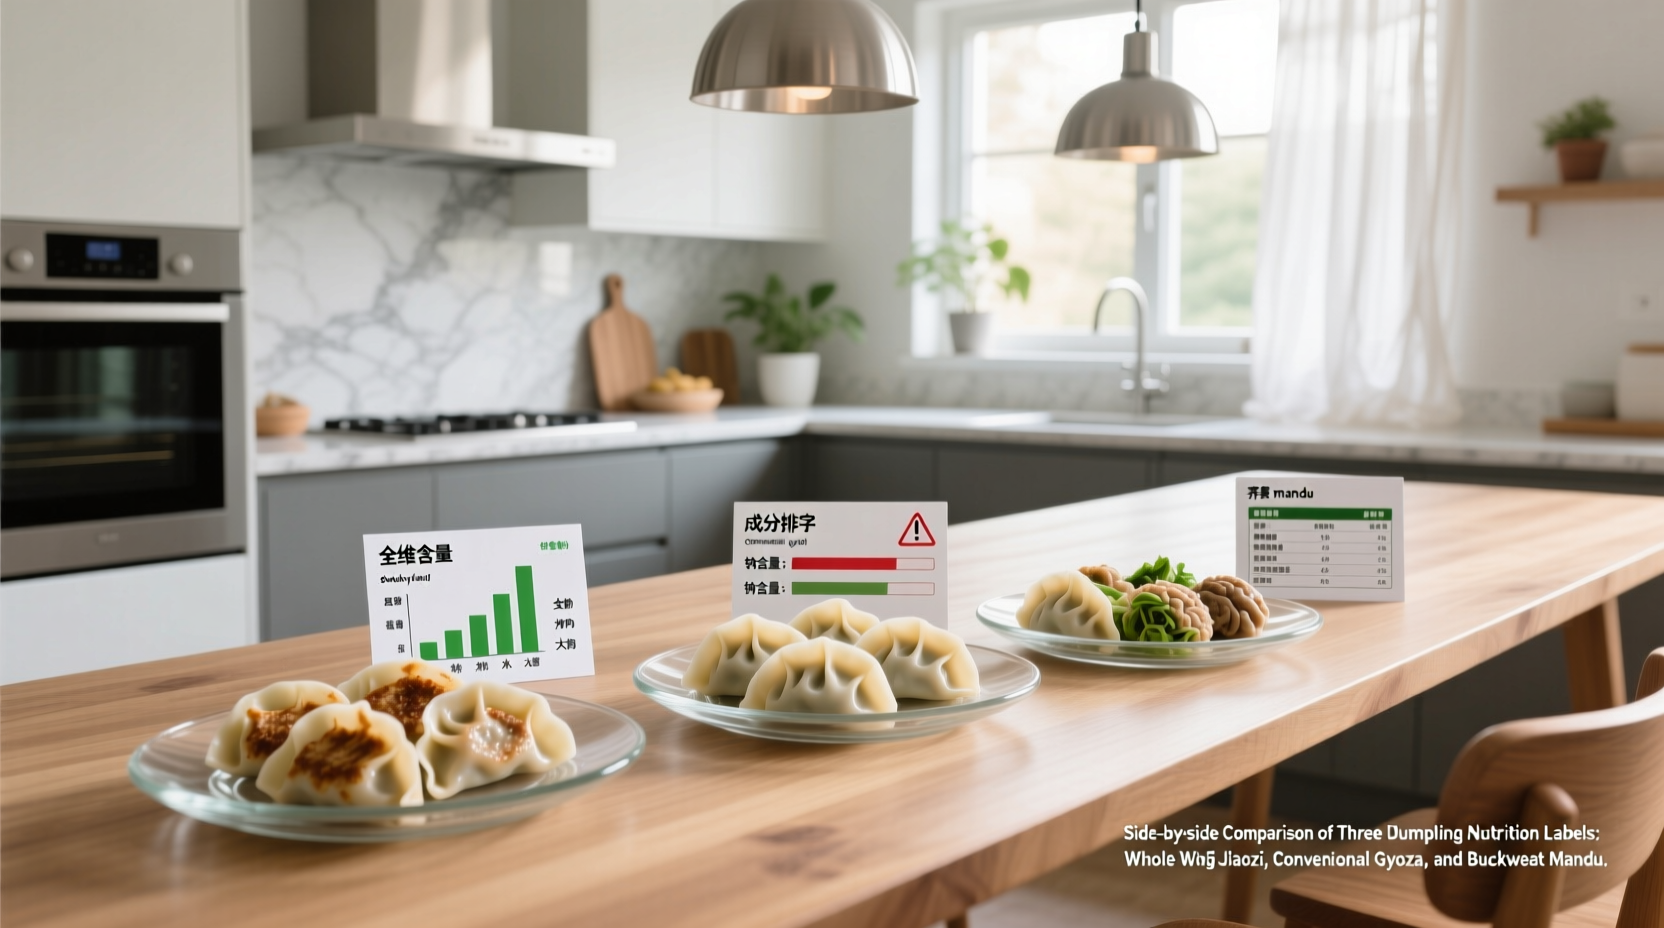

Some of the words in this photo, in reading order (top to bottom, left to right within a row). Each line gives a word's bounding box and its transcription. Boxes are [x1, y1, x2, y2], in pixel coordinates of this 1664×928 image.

[1273, 486, 1314, 499] mandu
[744, 512, 816, 534] 成分排字
[379, 543, 453, 566] 全维含量
